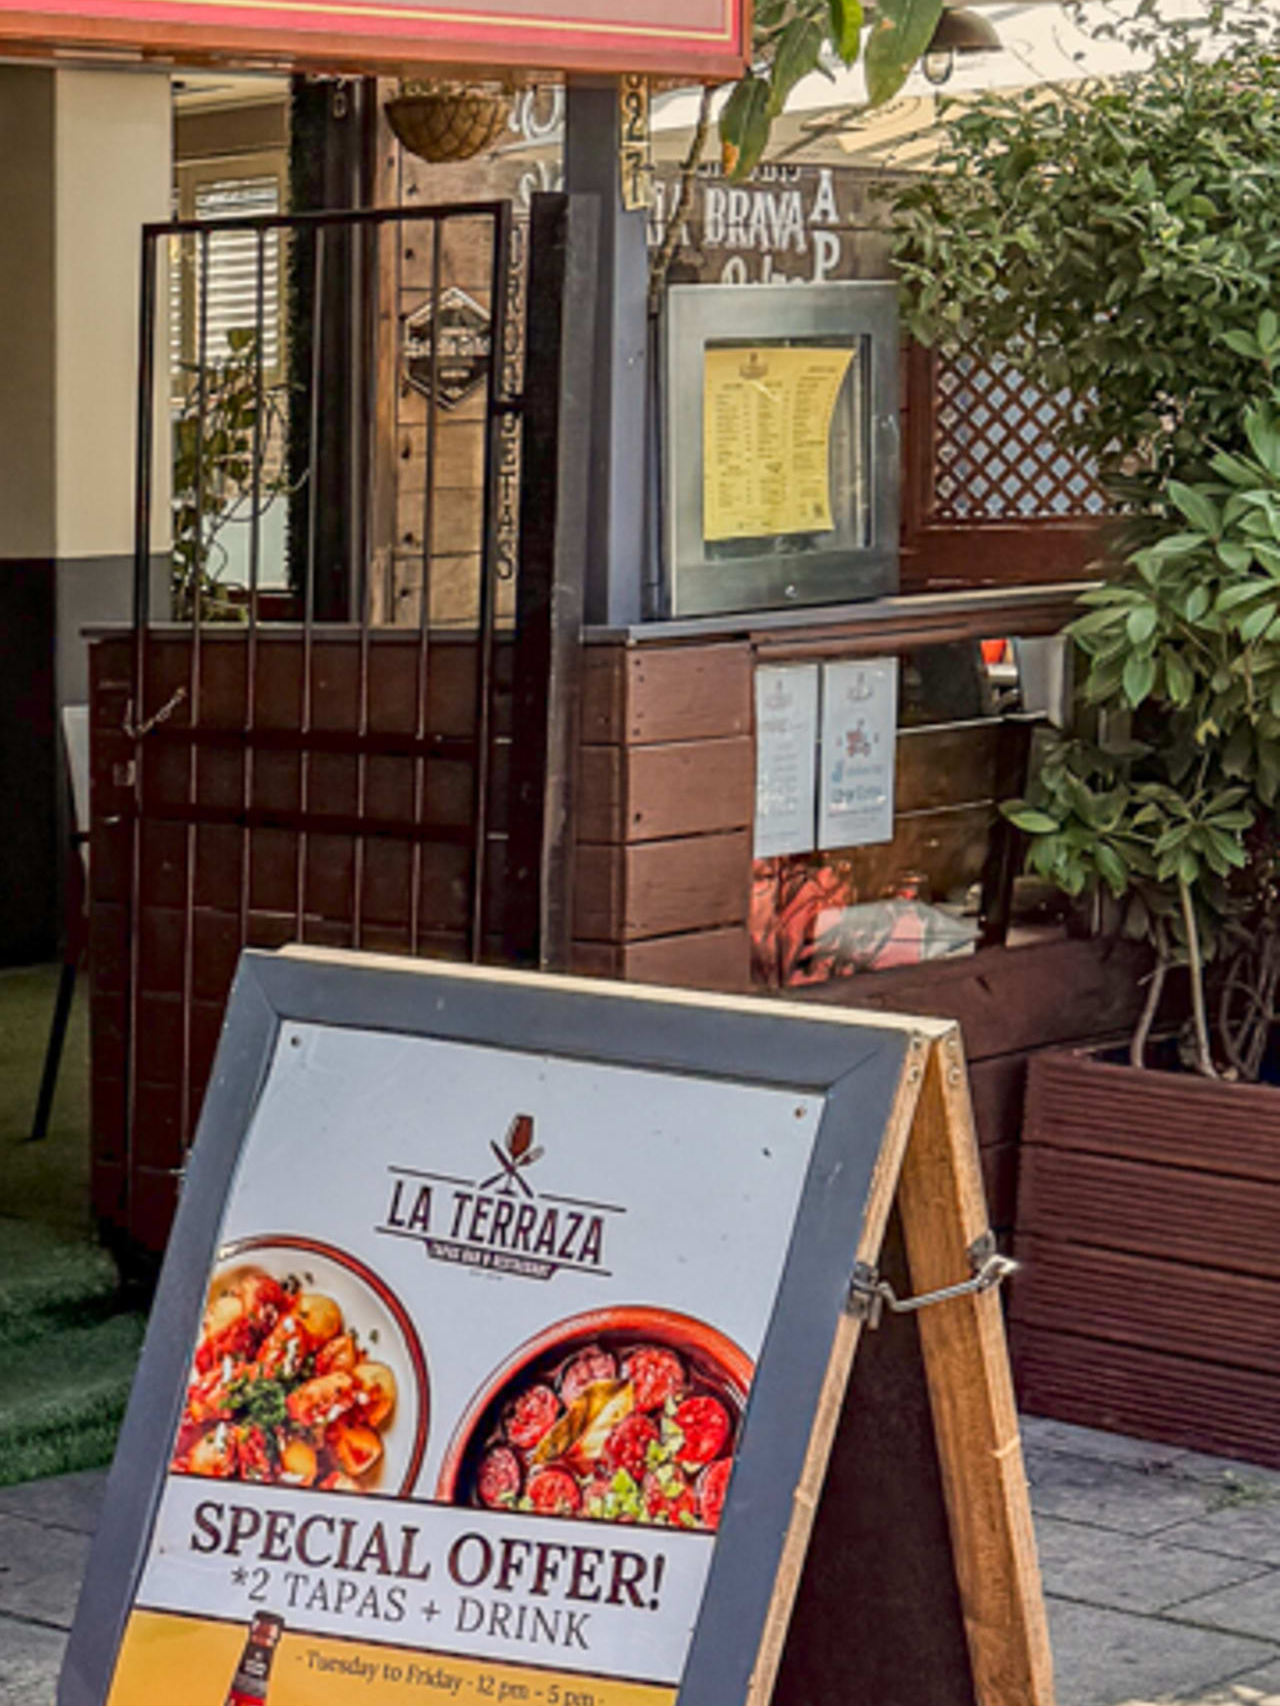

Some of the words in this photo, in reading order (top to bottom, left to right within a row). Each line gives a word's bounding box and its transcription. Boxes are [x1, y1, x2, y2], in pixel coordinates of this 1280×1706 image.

[704, 187, 807, 253] BRAVA
[387, 1180, 432, 1232] LA
[451, 1191, 604, 1265] TERRAZA
[190, 1500, 431, 1581] SPECIAL
[448, 1532, 666, 1611] OFFER!
[284, 1574, 407, 1623] TAPAS
[421, 1603, 441, 1624] +
[455, 1597, 592, 1650] DRINK
[307, 1650, 380, 1682] Tuesday
[382, 1662, 403, 1682] to
[405, 1664, 464, 1696] Friday
[476, 1675, 495, 1697] 12
[497, 1681, 530, 1702] pm
[547, 1684, 560, 1705] 5
